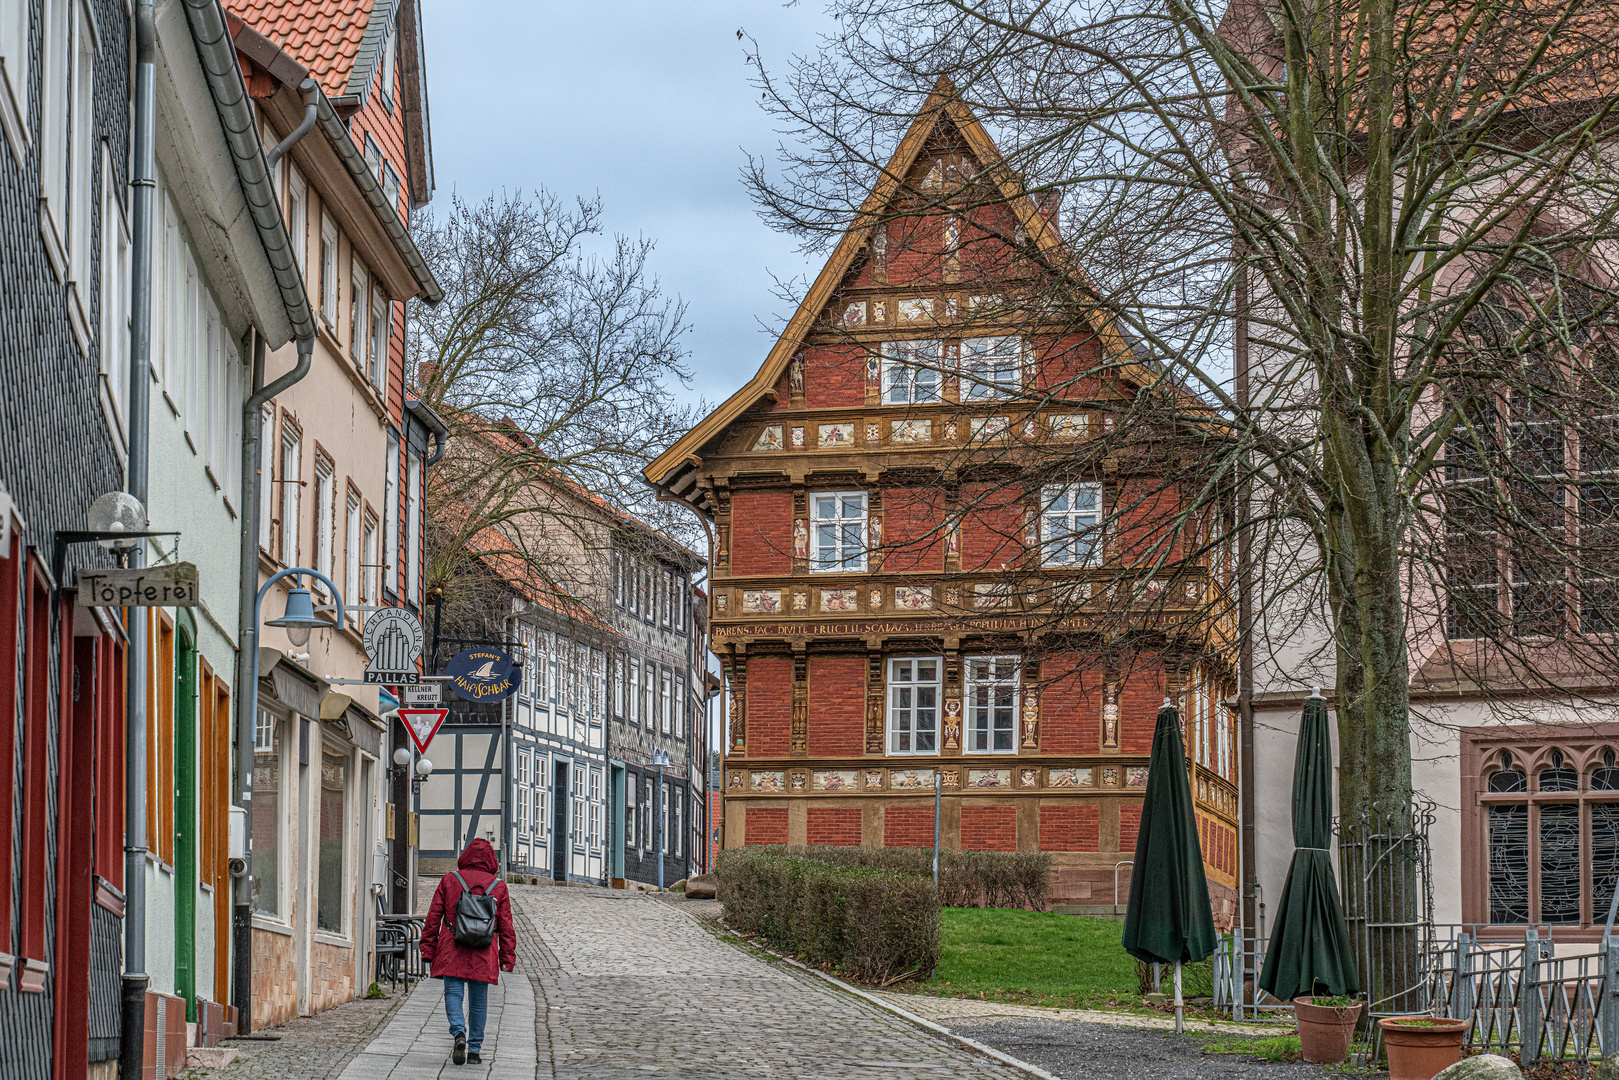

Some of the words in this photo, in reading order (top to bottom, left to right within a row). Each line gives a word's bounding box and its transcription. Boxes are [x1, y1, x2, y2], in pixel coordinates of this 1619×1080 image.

[81, 575, 196, 605] Töpferei
[364, 609, 423, 653] BUCHHANDLUNG
[469, 652, 501, 662] STEFAN'S
[368, 672, 417, 684] PALLAS
[407, 685, 432, 693] KELLNER
